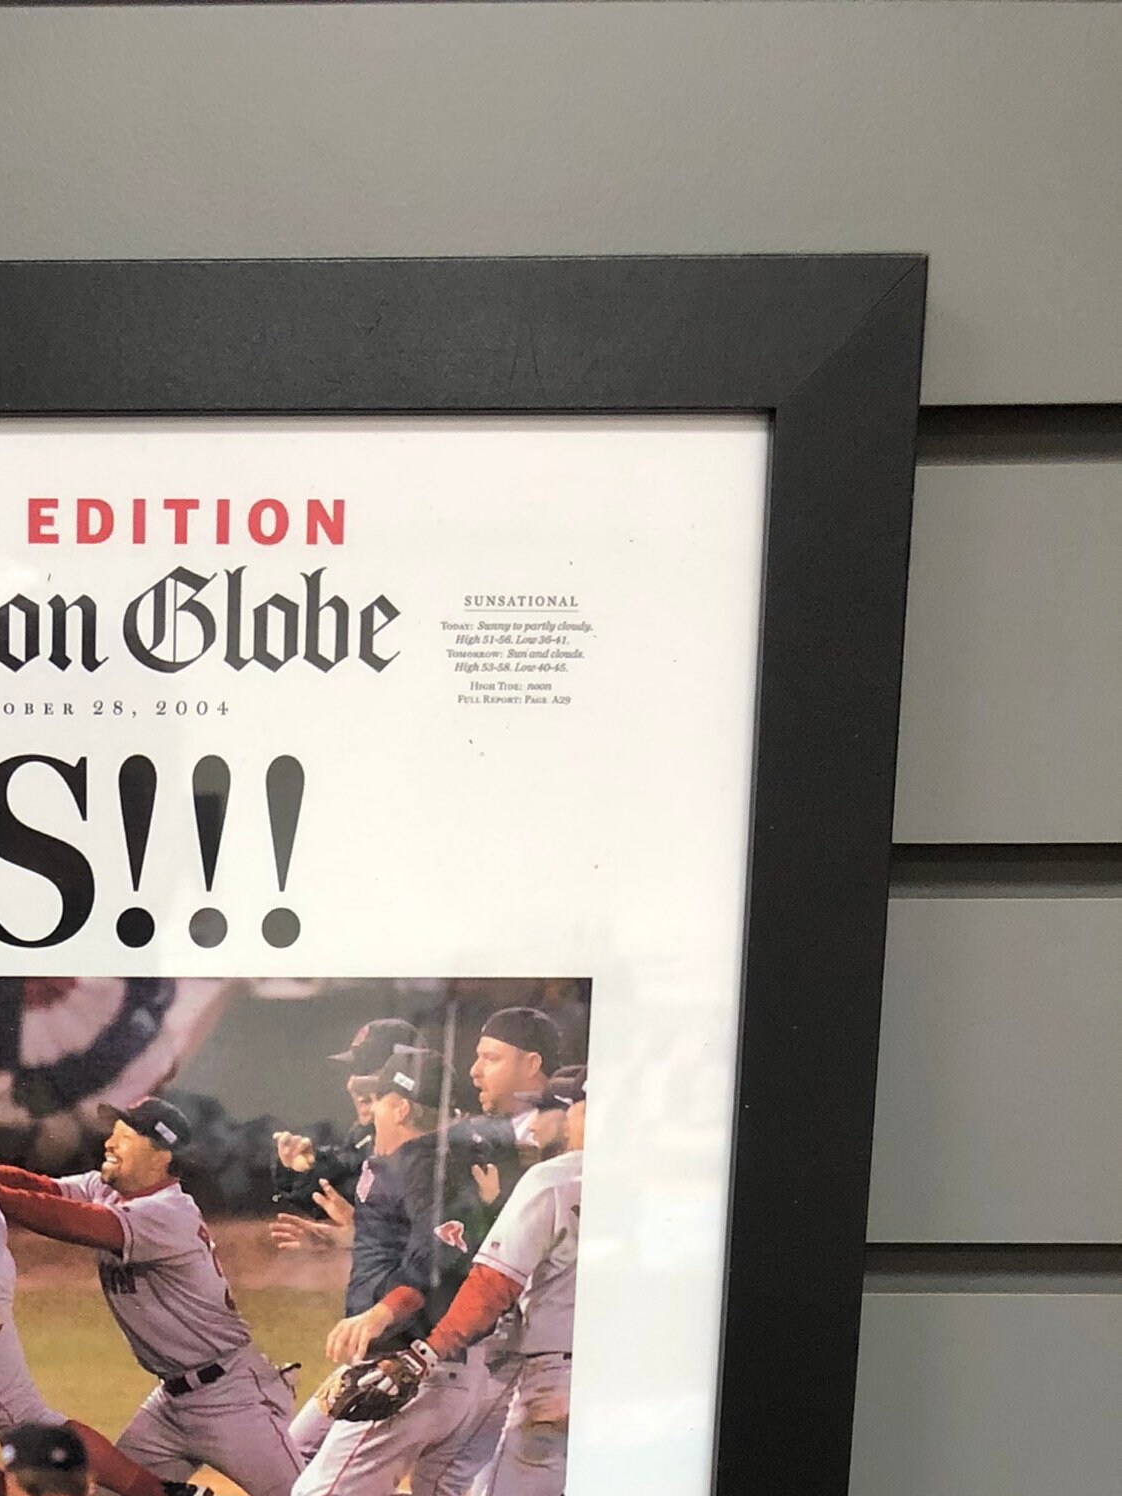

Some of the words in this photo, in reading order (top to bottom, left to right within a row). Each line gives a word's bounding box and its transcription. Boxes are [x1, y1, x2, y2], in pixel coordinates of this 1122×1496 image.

[28, 498, 344, 545] EDITION
[464, 595, 578, 606] SUNSATIONAL
[123, 565, 400, 673] Globe
[93, 700, 136, 717] 28,
[156, 700, 228, 715] 2004
